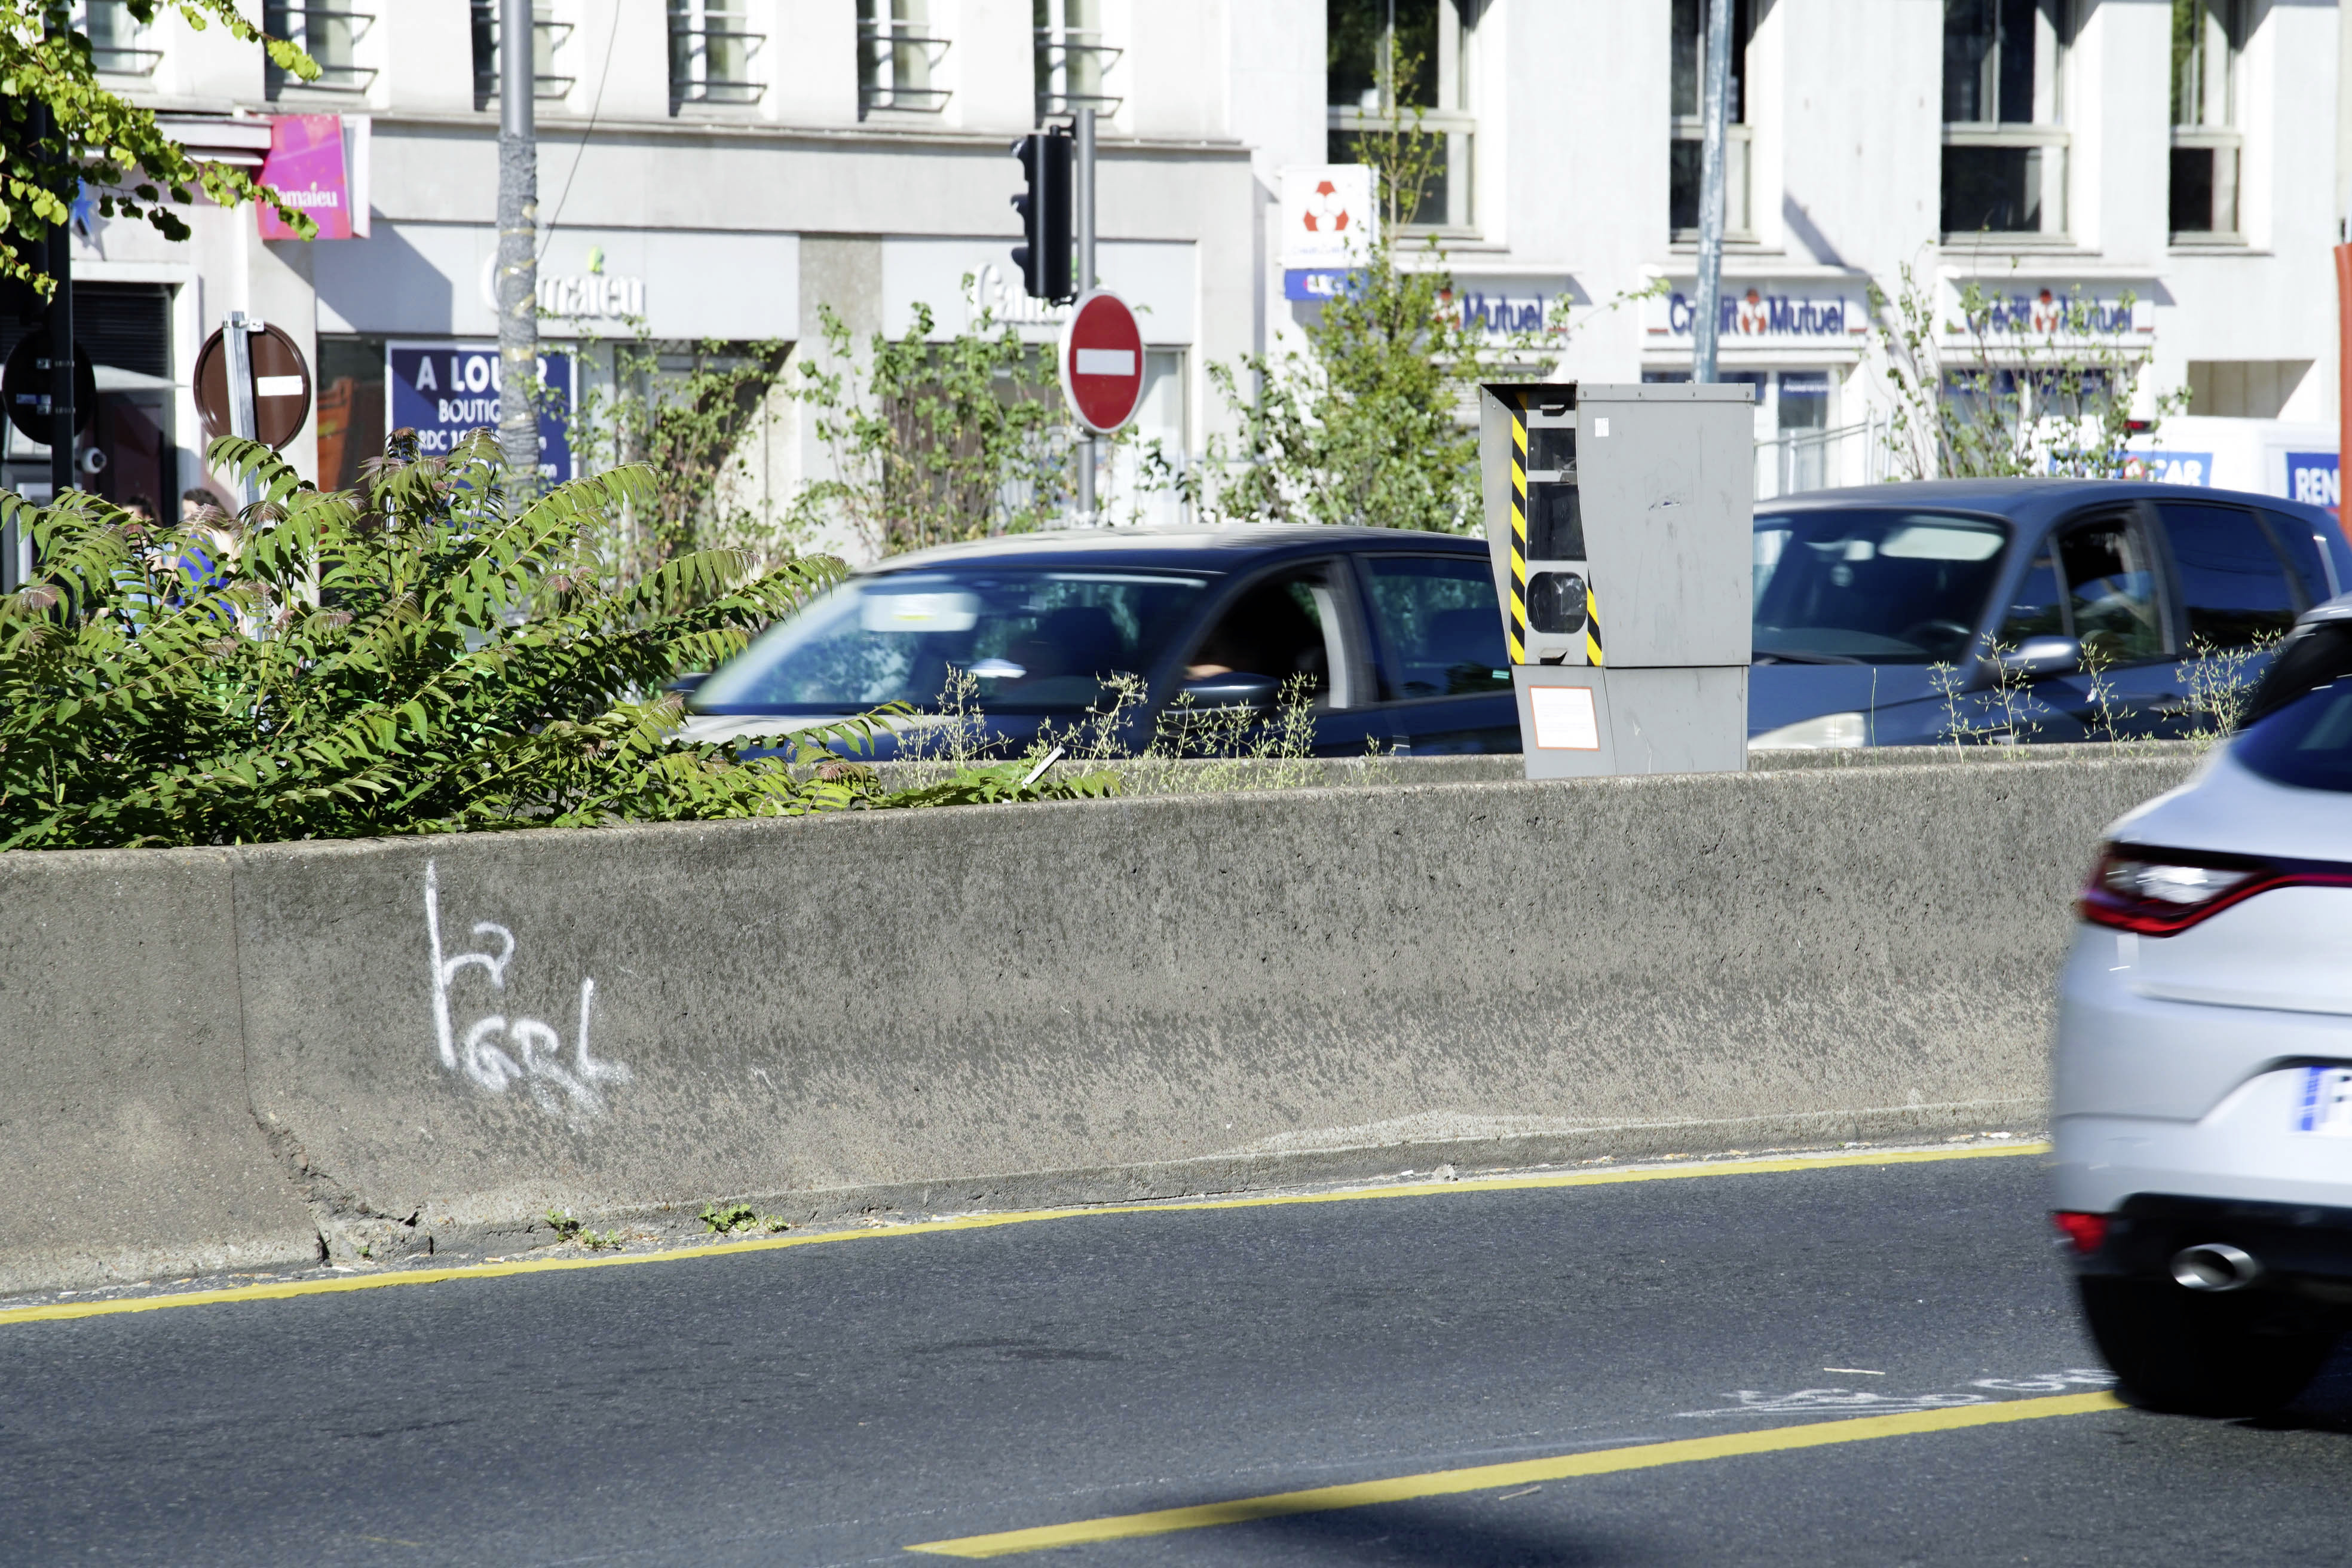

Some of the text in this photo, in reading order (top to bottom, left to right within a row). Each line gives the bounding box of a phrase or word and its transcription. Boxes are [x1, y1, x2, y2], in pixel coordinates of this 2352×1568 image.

[1463, 291, 1543, 335] Mutuel
[1768, 295, 1845, 335] Mutuel
[416, 356, 437, 390] A
[2295, 467, 2340, 506] REN
